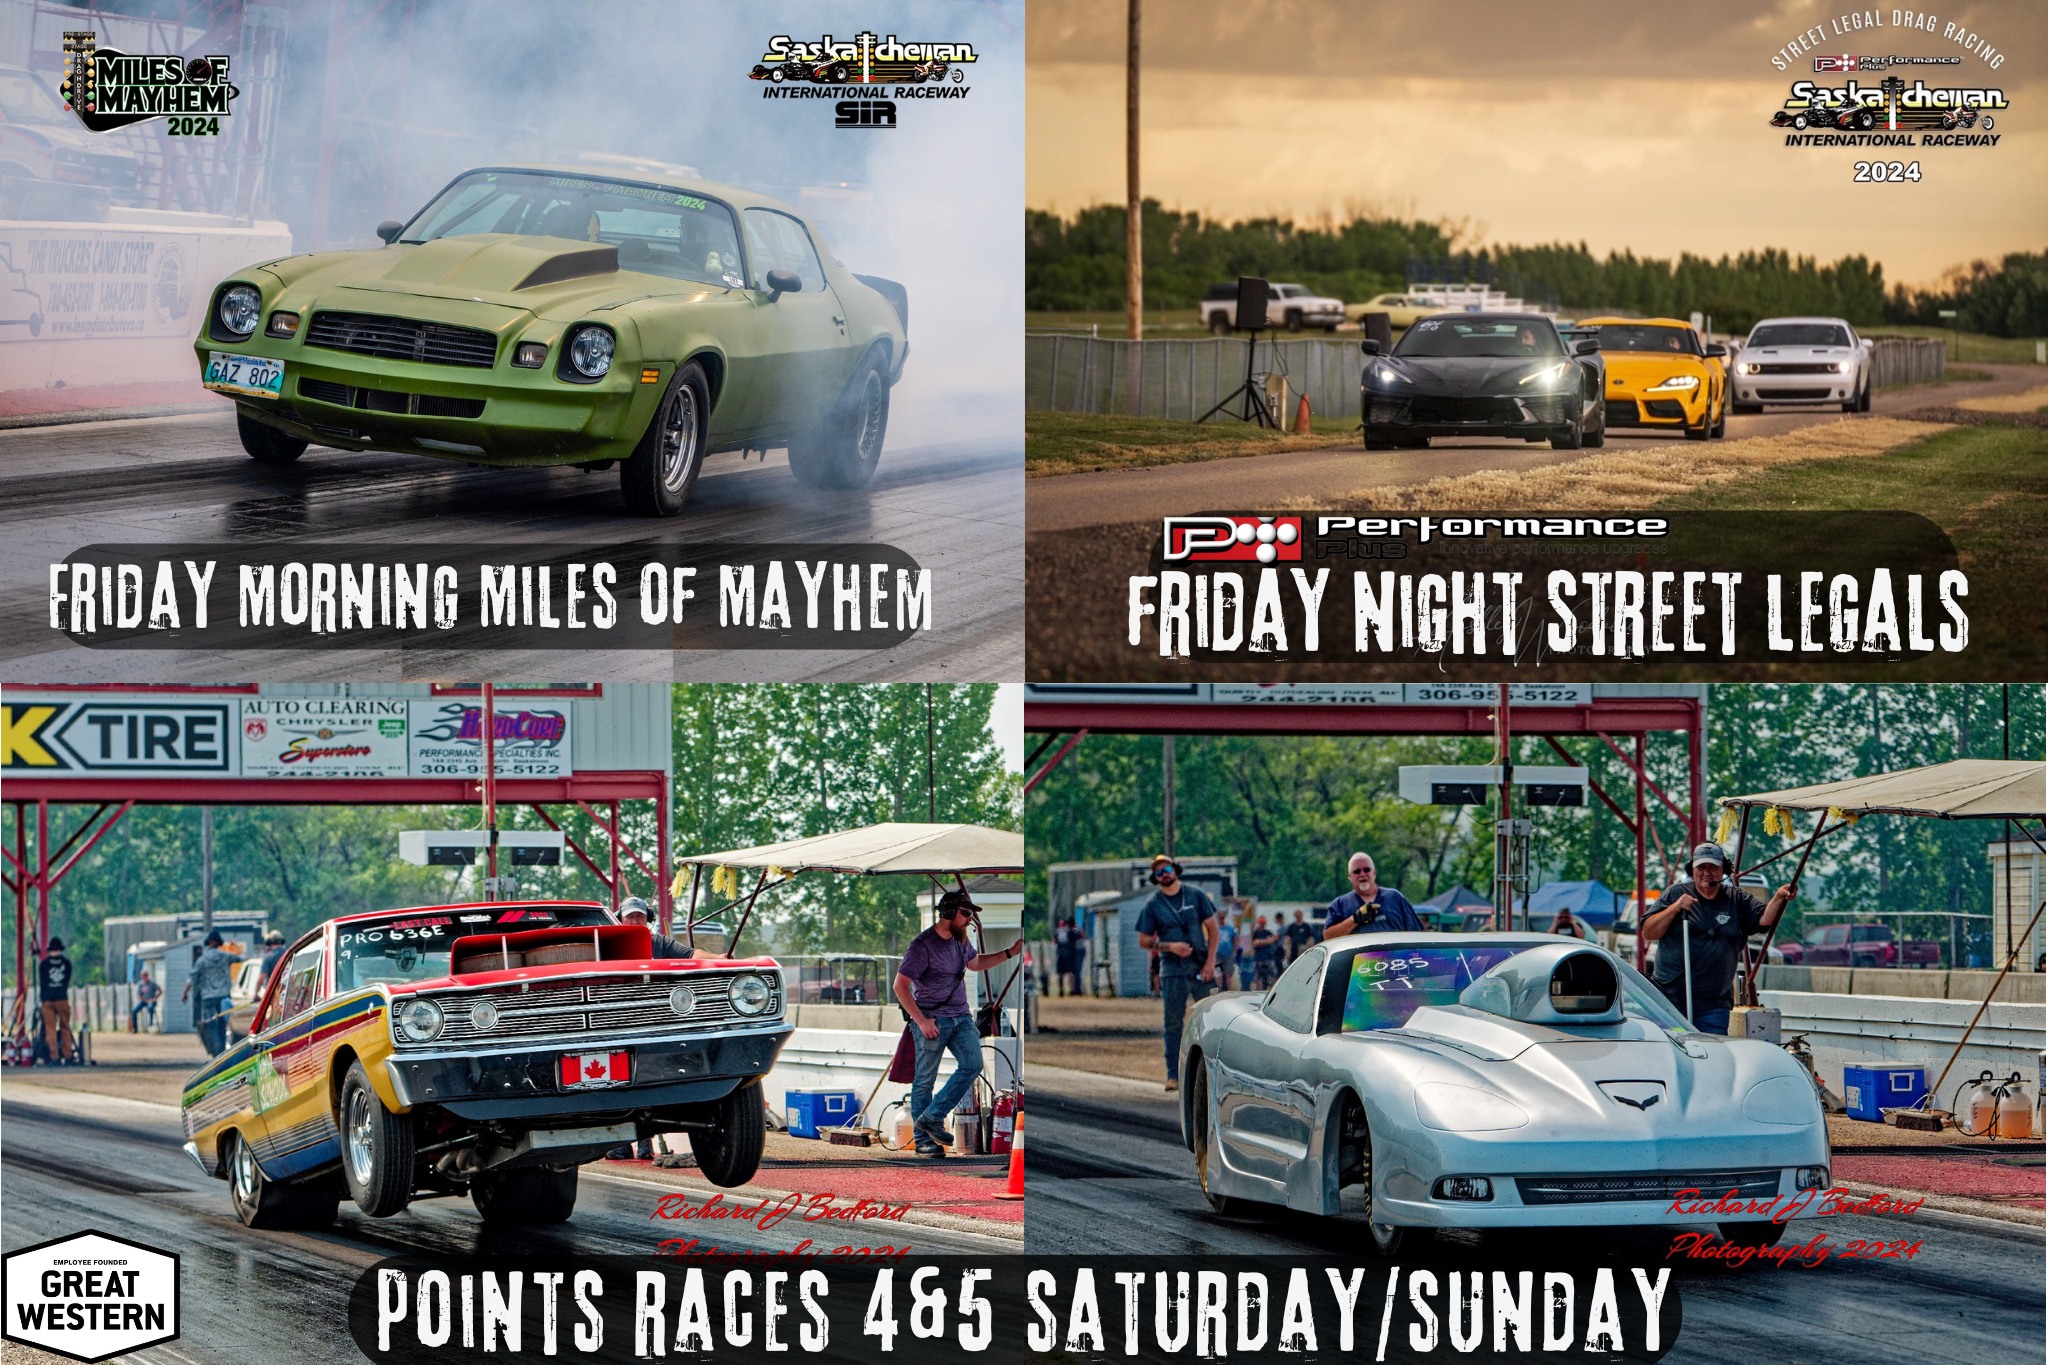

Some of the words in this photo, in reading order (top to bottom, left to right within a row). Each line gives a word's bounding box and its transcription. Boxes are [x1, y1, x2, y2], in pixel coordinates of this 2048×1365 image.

[674, 194, 706, 211] 2024
[47, 239, 92, 274] TRUCKERS
[92, 240, 124, 274] CANDY
[209, 361, 241, 383] GAZ
[248, 367, 279, 389] 802
[244, 701, 300, 715] AUTO
[304, 701, 406, 715] CLEARING
[276, 718, 374, 726] CHRYSLER
[381, 721, 402, 730] Jeep
[87, 714, 218, 760] TIRE
[488, 748, 543, 758] PECIALTIES
[543, 748, 561, 758] INC.
[392, 919, 421, 930] LAST
[424, 917, 453, 927] CALL
[339, 931, 384, 949] PRO
[389, 924, 446, 941] 636E
[1357, 957, 1430, 974] 6085
